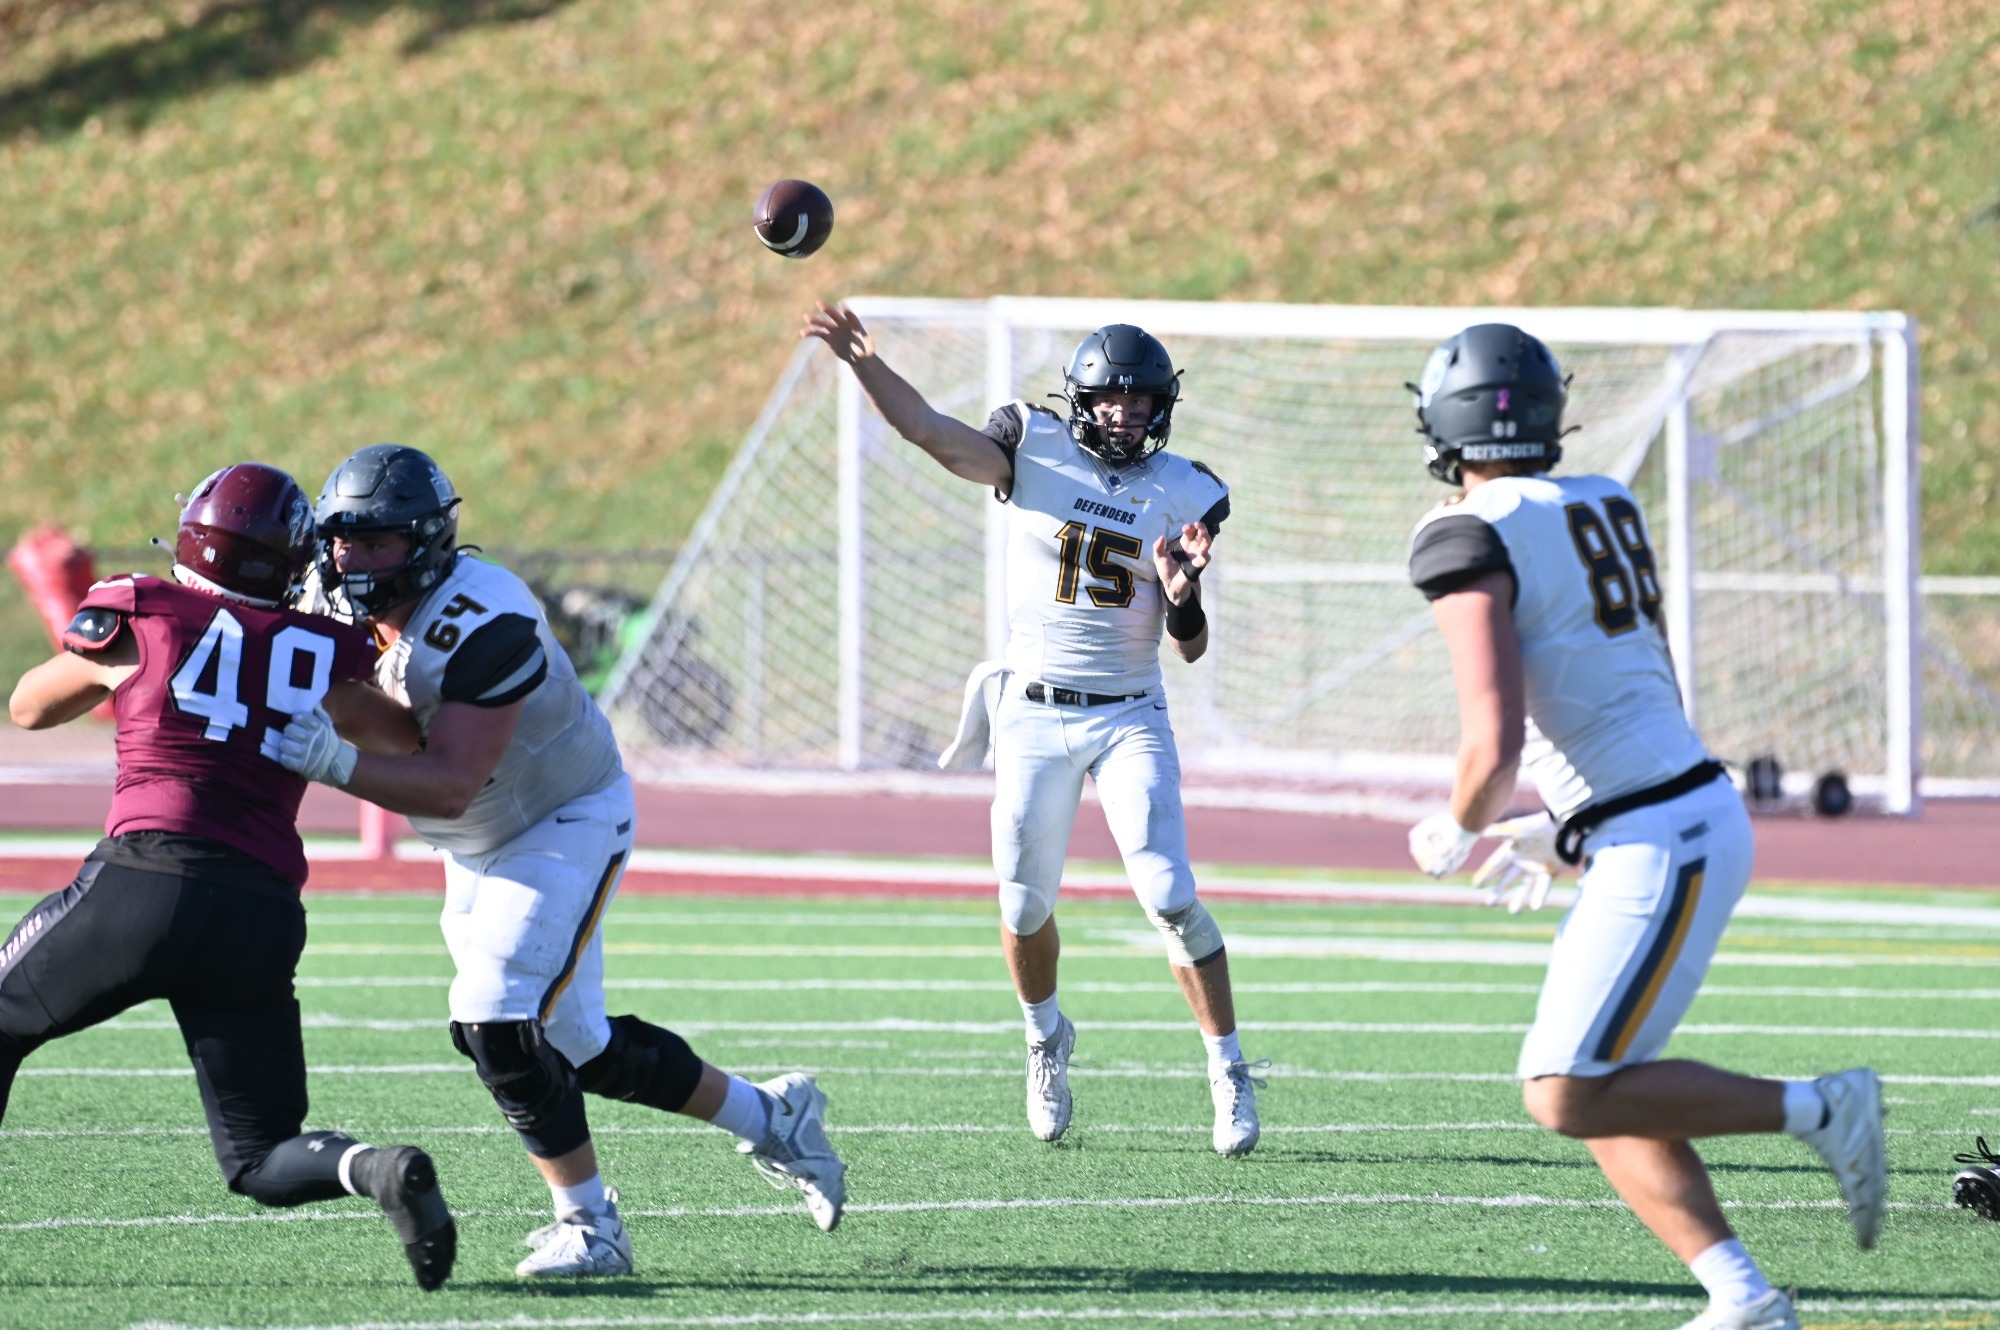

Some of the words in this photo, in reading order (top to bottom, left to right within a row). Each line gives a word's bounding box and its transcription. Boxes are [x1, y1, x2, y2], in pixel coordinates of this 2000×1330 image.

[1073, 497, 1137, 525] DEFENDERS
[1054, 519, 1143, 608] 15
[1564, 496, 1662, 639] 88
[423, 592, 489, 654] 64
[168, 606, 336, 763] 49
